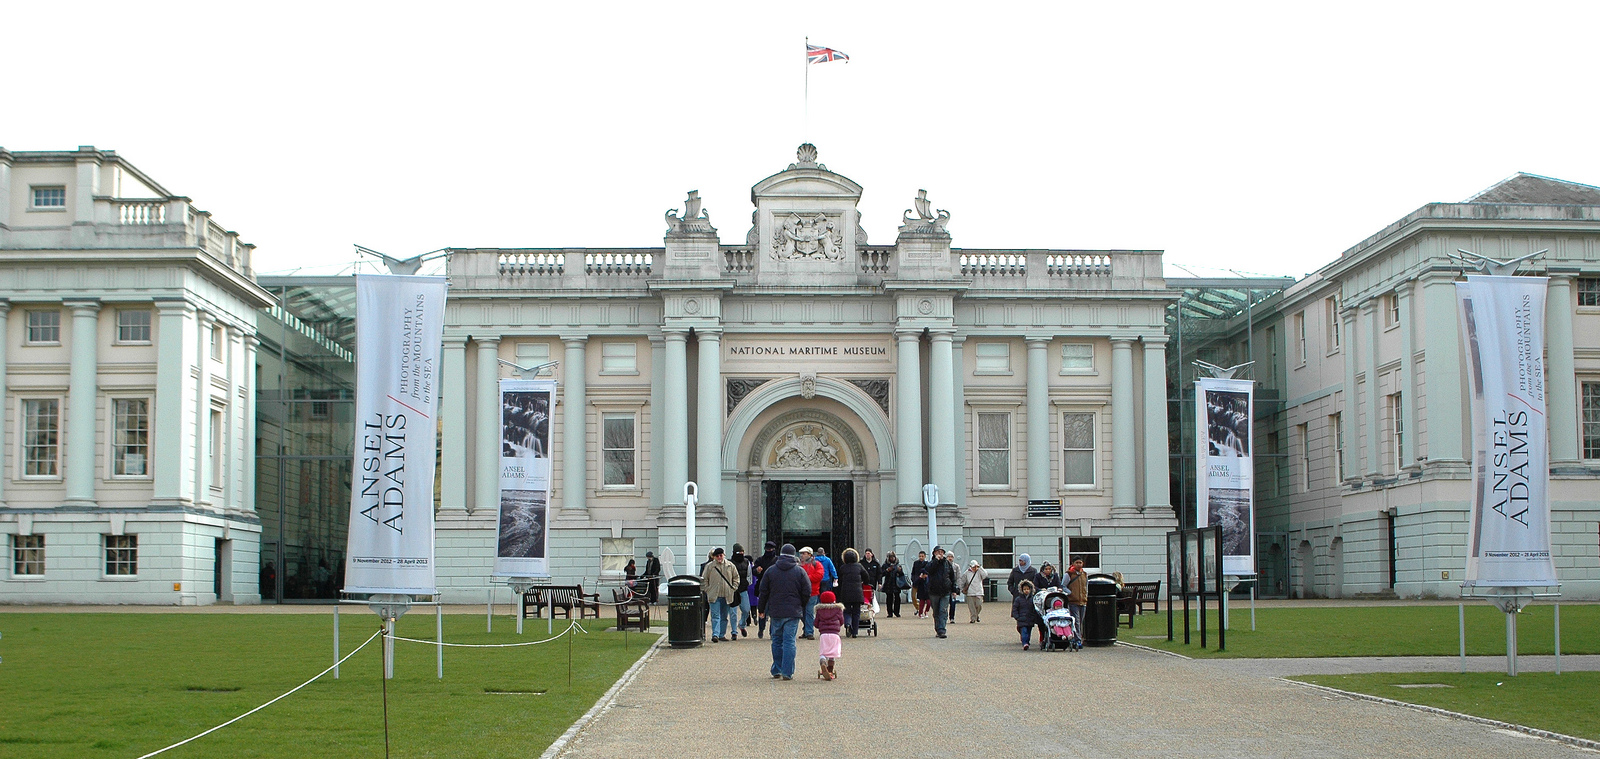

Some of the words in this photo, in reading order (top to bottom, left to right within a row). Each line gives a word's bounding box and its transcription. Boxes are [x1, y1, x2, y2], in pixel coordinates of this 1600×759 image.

[400, 308, 412, 394] PHOTOGRAPHY
[413, 294, 425, 363] MOUNTAINS
[731, 347, 785, 355] NATIONAL
[789, 347, 838, 355] MARITIME
[843, 347, 886, 355] MUSEUM
[1515, 307, 1526, 391] PHOTOGRAPHY
[1523, 294, 1532, 361] MOUNTAINS
[411, 377, 420, 400] from
[412, 363, 421, 377] the
[424, 358, 432, 380] SEA
[424, 395, 430, 404] to
[1537, 393, 1543, 401] to
[360, 412, 382, 525] ANSEL
[382, 413, 407, 535] ADAMS
[1491, 410, 1508, 520] ANSEL
[1508, 410, 1529, 529] ADAMS
